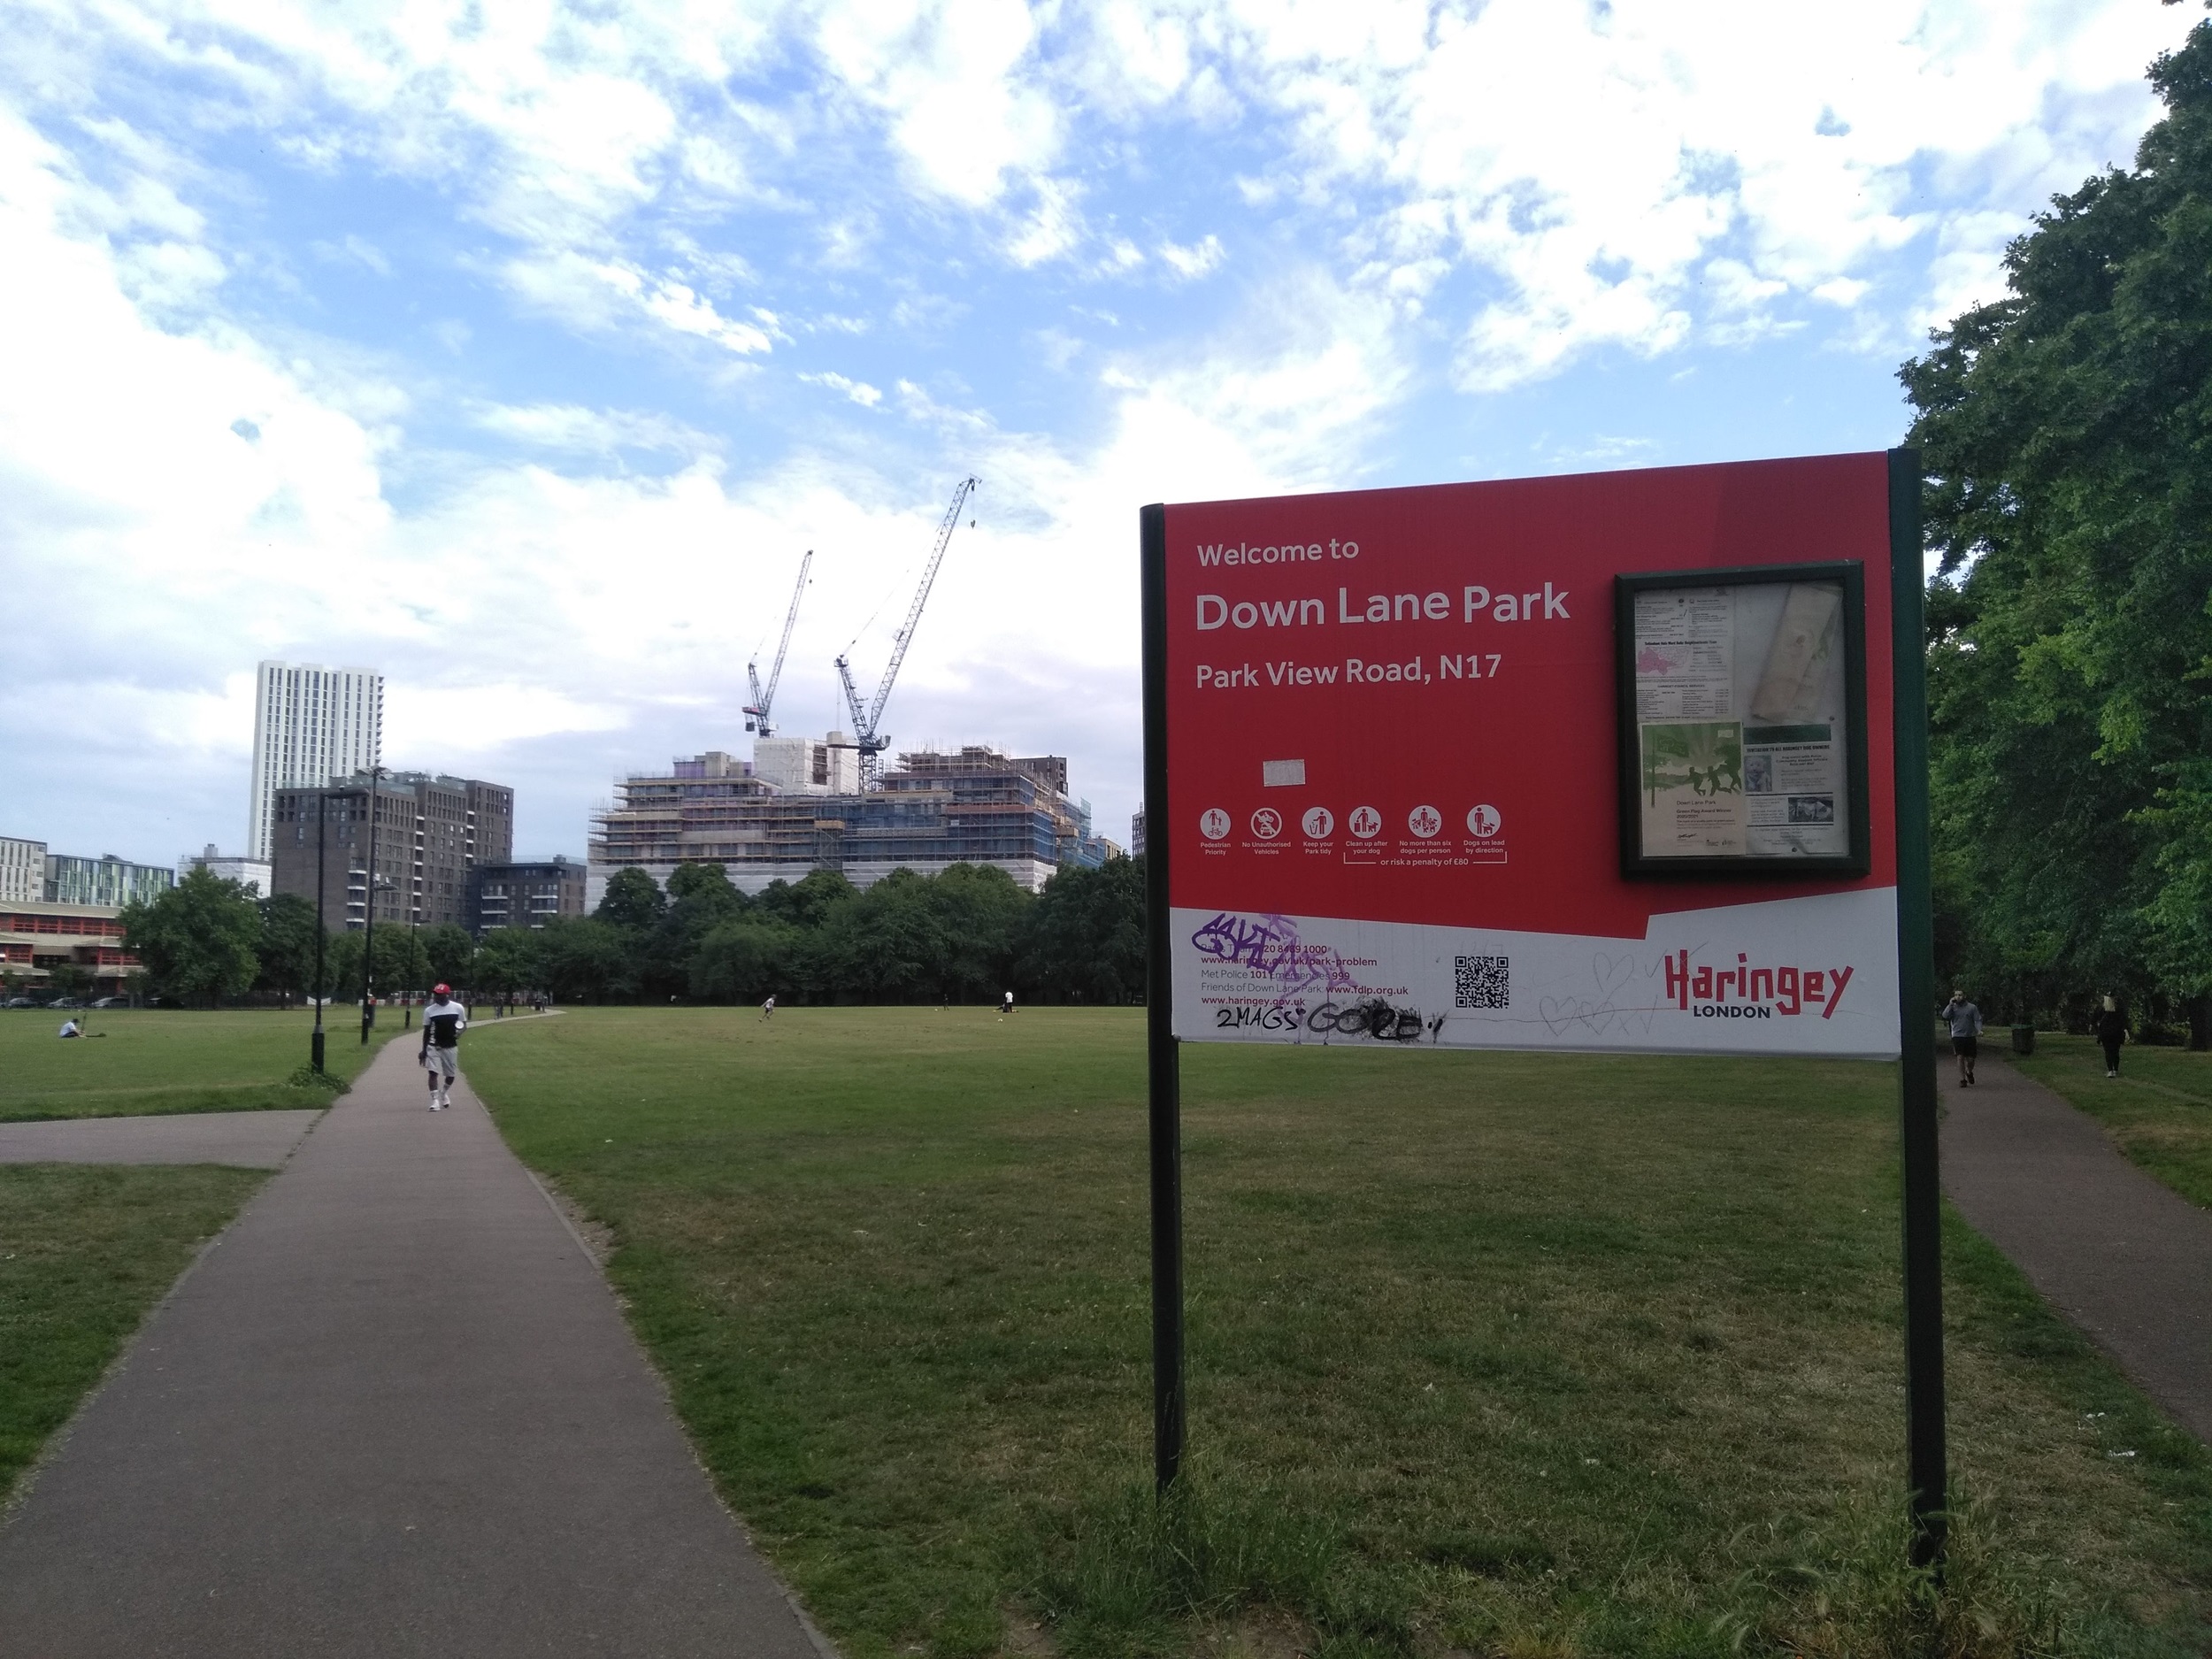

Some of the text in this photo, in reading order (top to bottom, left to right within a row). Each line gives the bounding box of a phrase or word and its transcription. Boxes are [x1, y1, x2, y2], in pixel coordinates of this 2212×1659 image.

[1198, 539, 1359, 566] Welcome to
[1197, 582, 1571, 630] Down Lane Park
[1198, 654, 1501, 688] Park View Road, N17
[1303, 841, 1317, 849] Keep
[1463, 840, 1479, 849] Dogs
[1412, 857, 1442, 867] penalty
[1304, 945, 1327, 954] 1000
[1202, 970, 1218, 979] Met
[1221, 970, 1248, 979] Police
[1664, 949, 1855, 1018] Haringey
[1202, 983, 1239, 992] Friends
[1241, 983, 1247, 992] of
[1326, 986, 1409, 996] www.fdlp.org.uk
[1202, 996, 1305, 1007] www.haringey.gov.uk
[1694, 1006, 1770, 1018] LONDON
